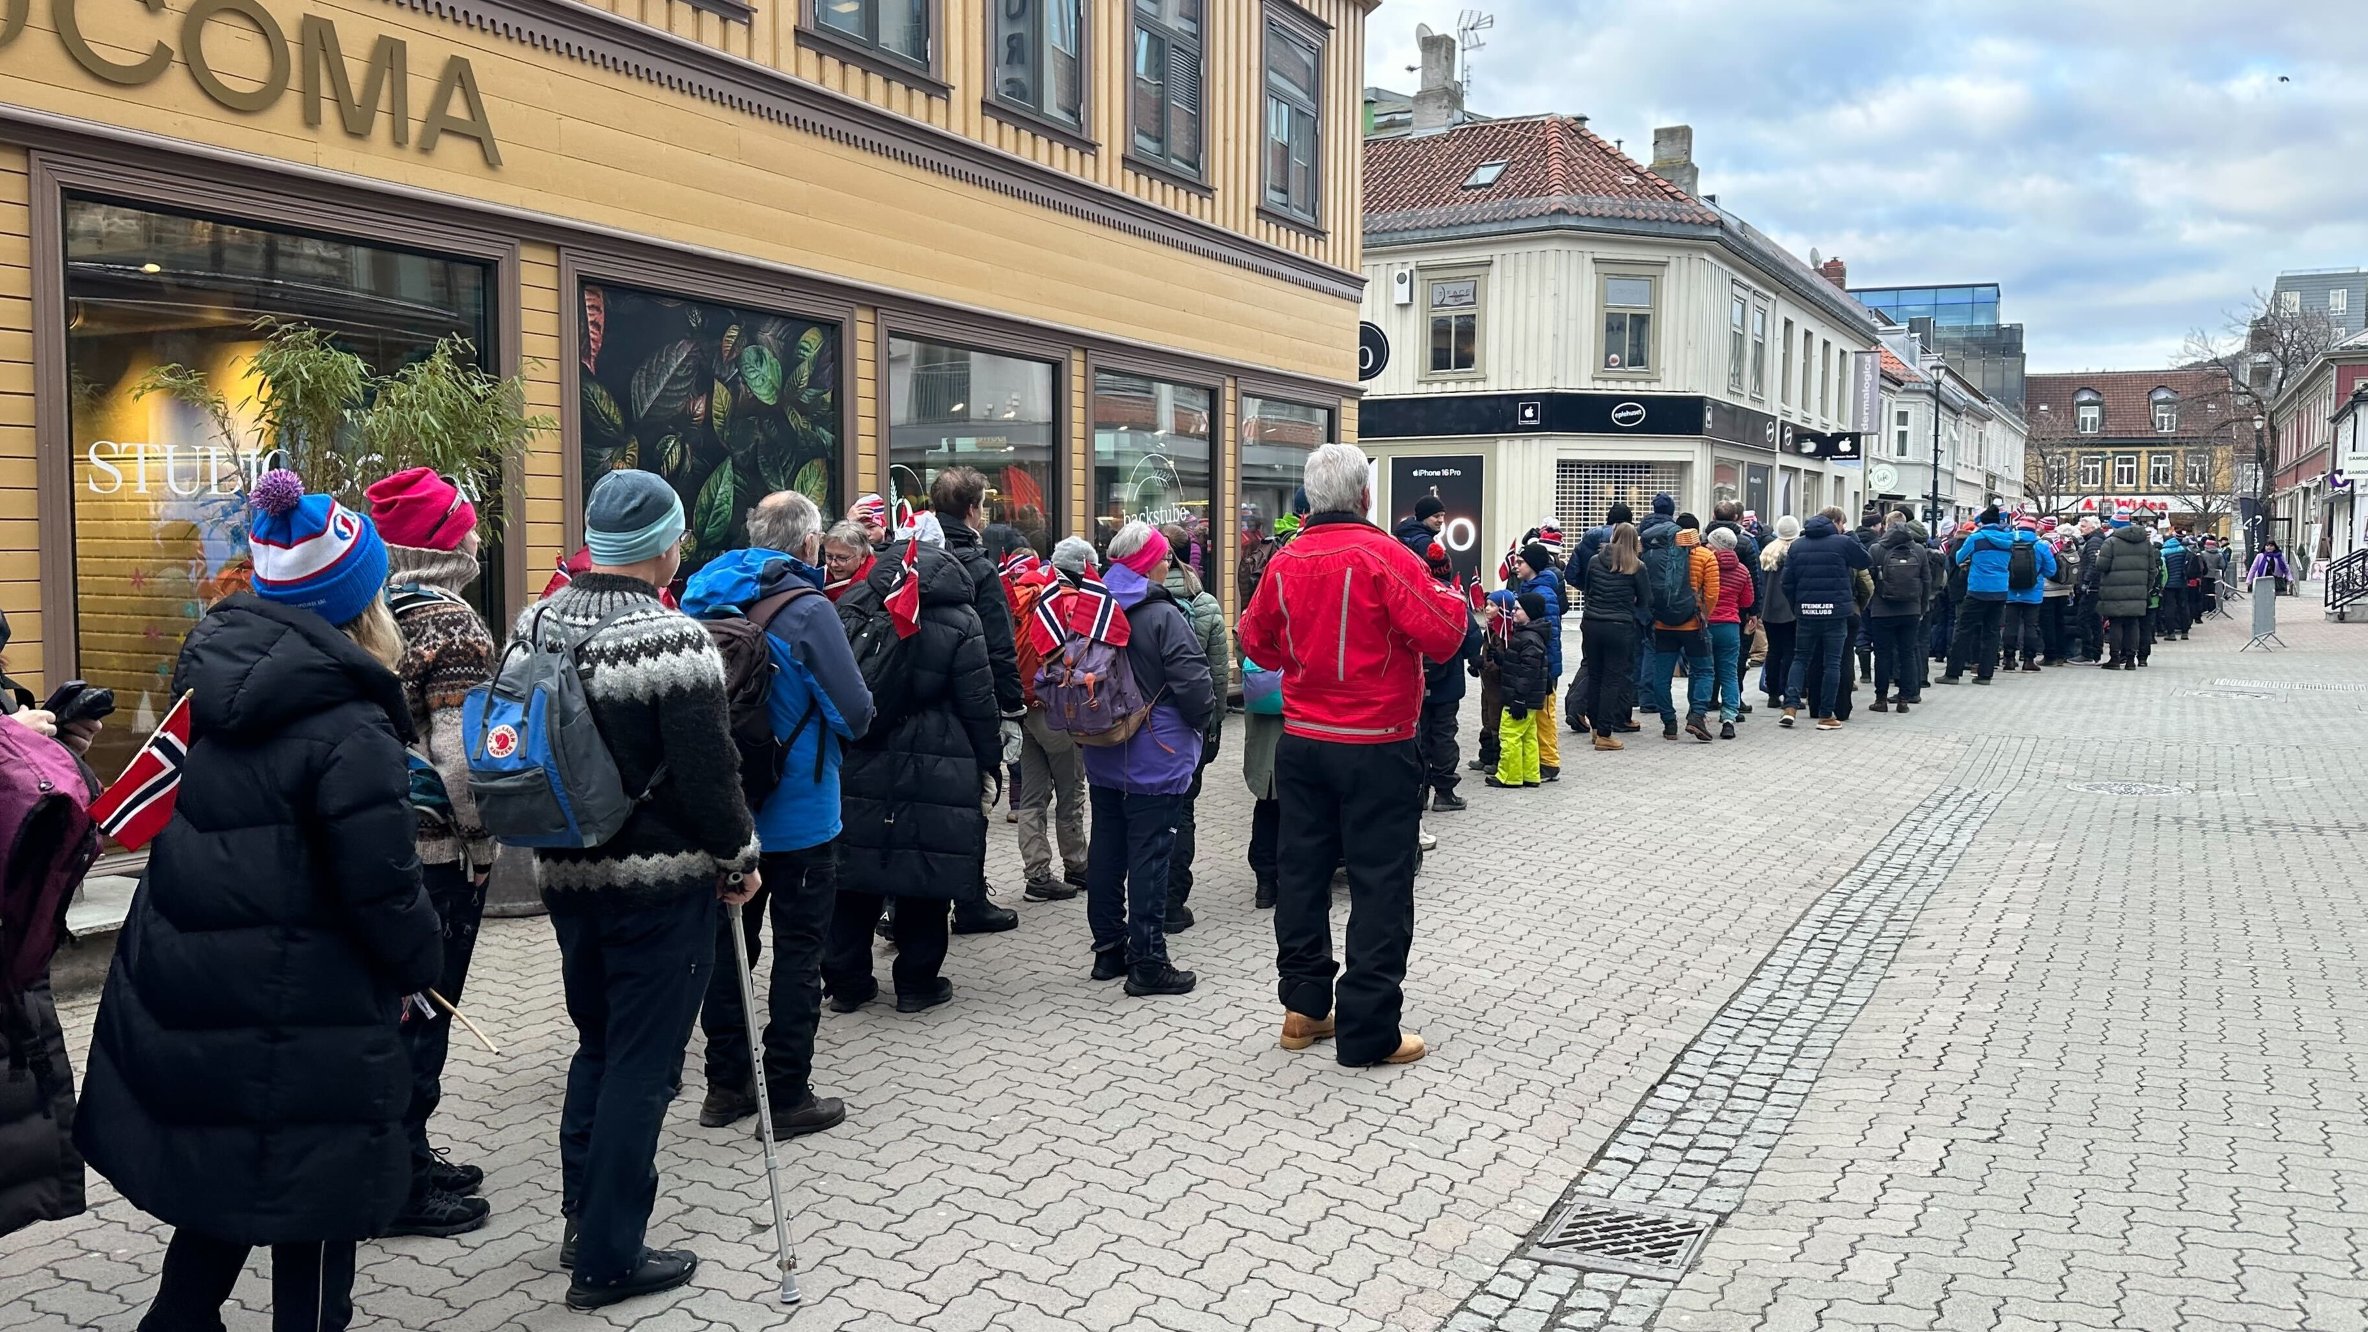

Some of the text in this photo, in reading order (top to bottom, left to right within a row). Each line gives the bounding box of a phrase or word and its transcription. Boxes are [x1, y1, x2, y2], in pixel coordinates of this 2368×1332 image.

[0, 0, 503, 166] COMA
[1861, 355, 1872, 431] dermalogica
[1614, 409, 1642, 420] eplehuset
[1418, 469, 1441, 477] iPhone
[1450, 468, 1461, 476] Pro
[1122, 502, 1187, 525] backstube
